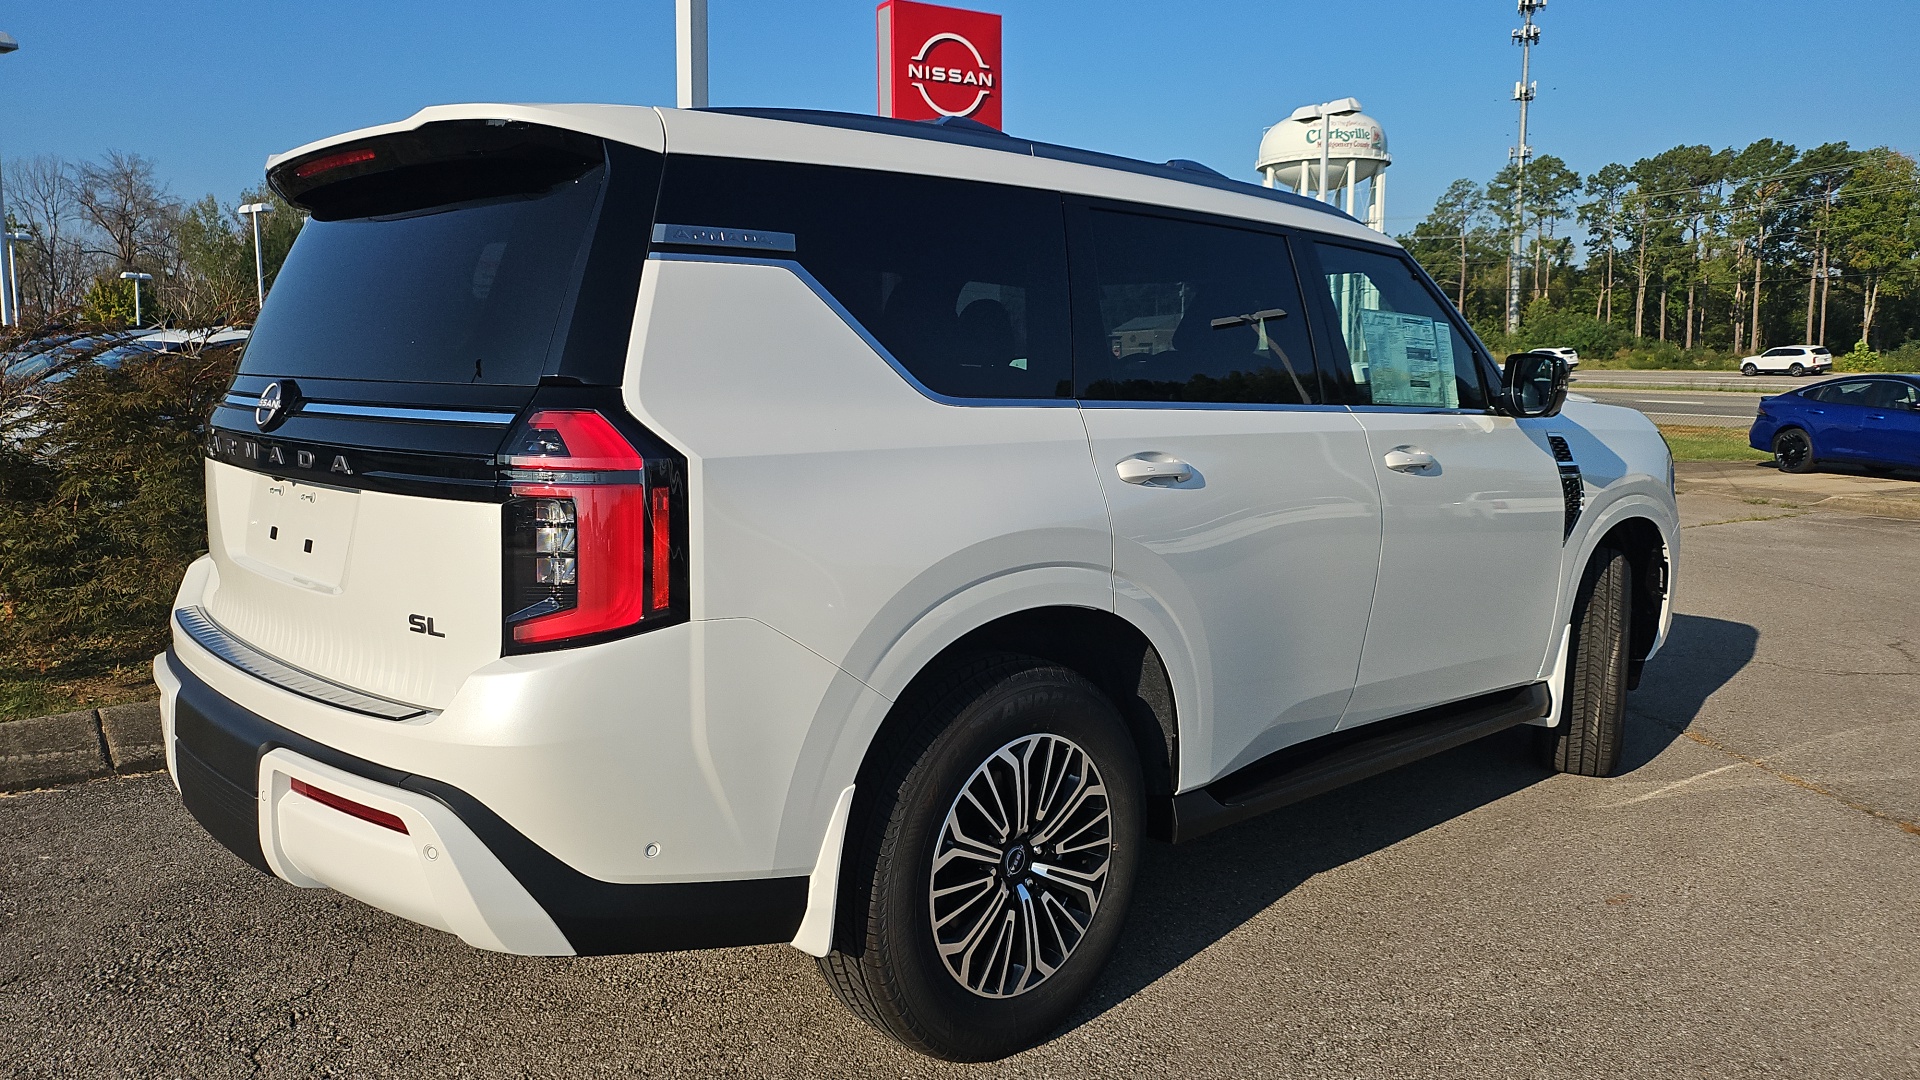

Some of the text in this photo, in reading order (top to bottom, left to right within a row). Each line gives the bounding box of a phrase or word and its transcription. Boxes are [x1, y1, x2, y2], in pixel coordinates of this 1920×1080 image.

[908, 63, 993, 88] NISSAN
[1306, 128, 1371, 144] Clrksville
[408, 613, 446, 638] SL
